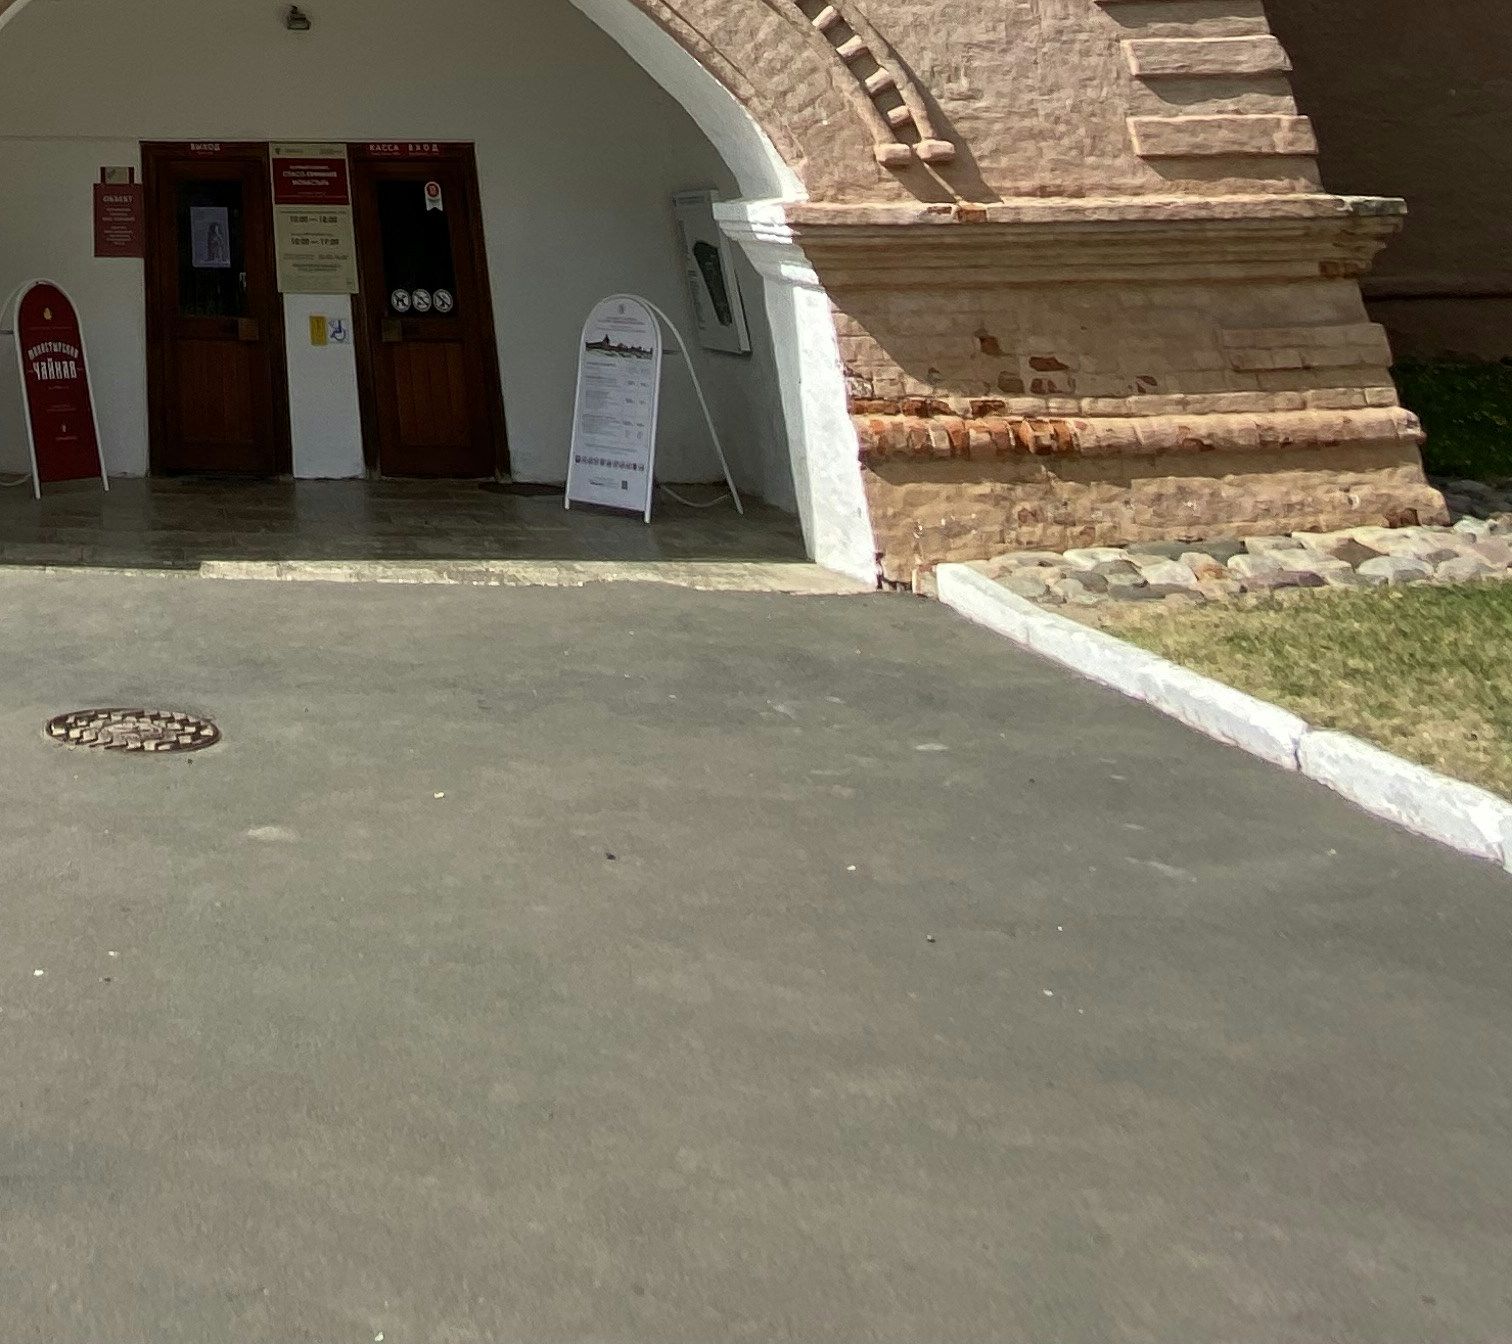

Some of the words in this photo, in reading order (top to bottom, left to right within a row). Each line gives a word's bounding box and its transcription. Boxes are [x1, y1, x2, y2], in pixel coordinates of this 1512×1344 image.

[190, 143, 221, 151] ВЫХОД
[369, 144, 400, 152] КАССА
[408, 144, 440, 152] ВХОД
[32, 357, 78, 380] ЧАЙНАЯ
